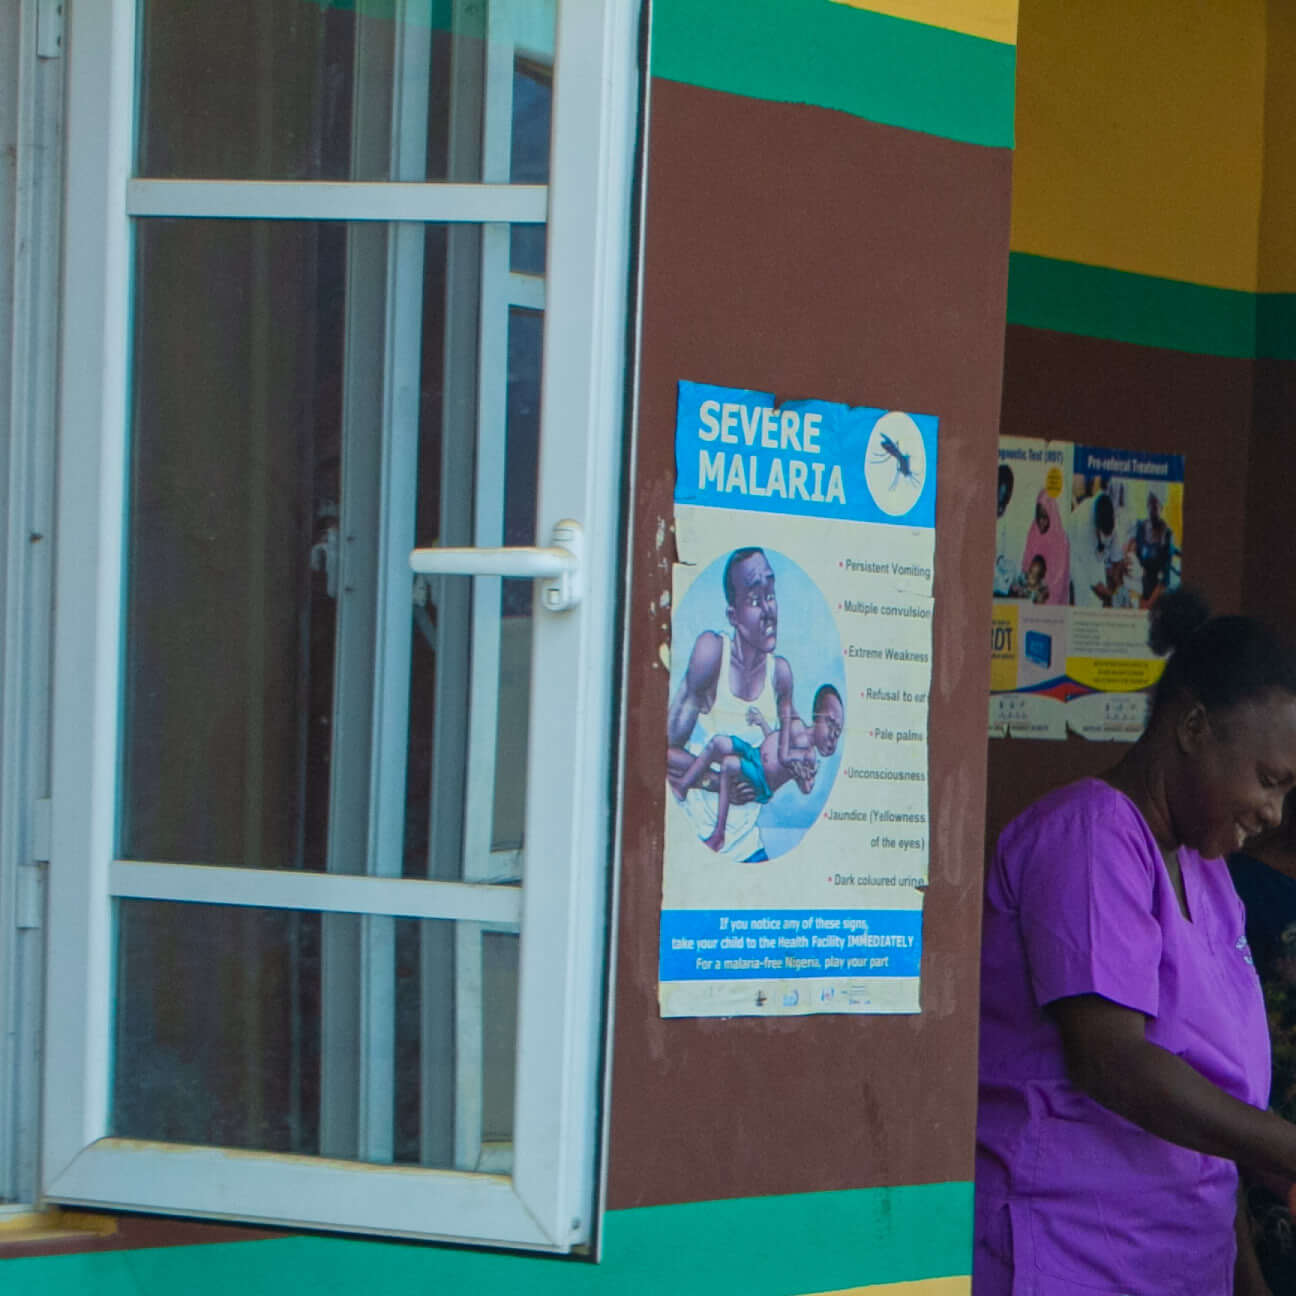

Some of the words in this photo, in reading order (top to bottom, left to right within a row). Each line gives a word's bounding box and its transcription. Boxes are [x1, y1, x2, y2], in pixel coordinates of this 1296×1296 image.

[698, 400, 823, 454] SEVERE
[698, 450, 847, 505] MALARIA
[845, 559, 889, 575] Persistent
[891, 563, 932, 580] Vomiting
[844, 601, 879, 616] Multiple
[849, 646, 883, 660] Extreme
[885, 648, 929, 663] Weakness
[866, 688, 900, 701] Refusal
[903, 691, 913, 702] to
[874, 728, 894, 740] Pale
[847, 767, 926, 781] Unconsciousness
[827, 809, 867, 821] Jaundice
[869, 809, 926, 824] (Yellowness
[870, 836, 880, 848] of
[881, 836, 896, 848] the
[898, 837, 926, 851] eyes)
[834, 874, 855, 886] Dark
[857, 874, 897, 886] coloured
[719, 917, 729, 930] If
[730, 919, 748, 932] you
[750, 917, 781, 930] notice
[783, 919, 800, 933] any
[801, 916, 814, 929] of
[815, 917, 841, 929] these
[671, 938, 695, 950] take
[696, 939, 718, 952] your
[720, 936, 745, 949] child
[746, 937, 757, 949] to
[759, 937, 776, 949] the
[778, 935, 809, 948] Health
[811, 935, 845, 951] Facility
[847, 935, 914, 948] IMMEDIATELY
[696, 958, 713, 970] For
[714, 960, 721, 970] a
[824, 955, 845, 970] play
[847, 957, 867, 970] your
[869, 956, 889, 969] part
